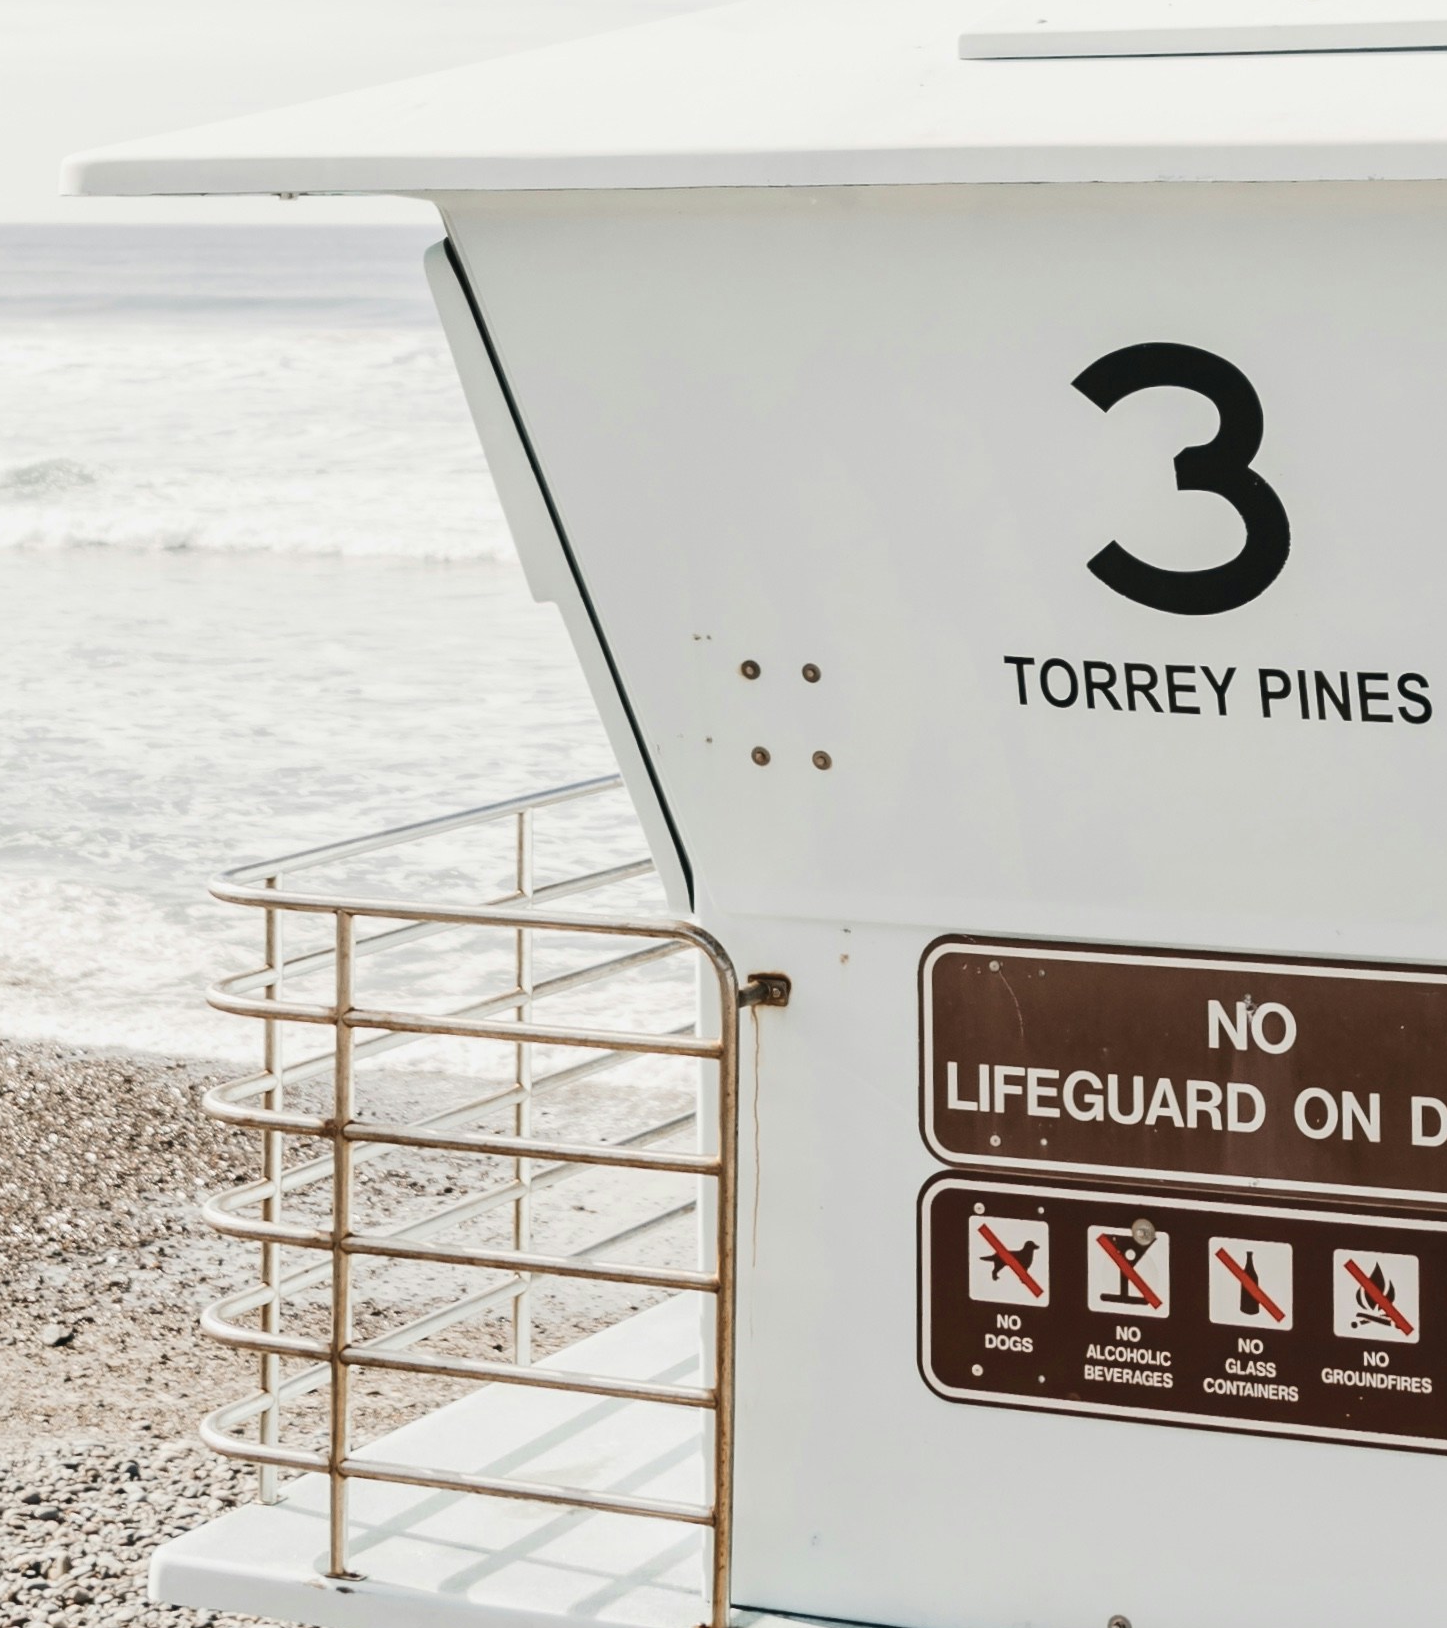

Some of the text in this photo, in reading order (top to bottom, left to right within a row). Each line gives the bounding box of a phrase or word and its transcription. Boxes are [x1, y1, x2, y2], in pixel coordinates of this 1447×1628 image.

[1071, 343, 1290, 615] 3
[1004, 656, 1432, 724] TORREY PINES
[1208, 1000, 1296, 1054] NO
[948, 1062, 1266, 1132] LIFEGUARD
[1294, 1088, 1380, 1142] ON
[997, 1314, 1021, 1330] NO
[985, 1334, 1033, 1352] DOGS
[1117, 1326, 1141, 1342] NO
[1086, 1344, 1172, 1366] ALCOHOLIC
[1239, 1338, 1263, 1354] NO
[1226, 1359, 1276, 1377] GLASS
[1364, 1352, 1389, 1367] NO
[1085, 1365, 1173, 1387] BEVERAGES
[1322, 1368, 1432, 1393] GROUNDFIRES
[1204, 1378, 1298, 1401] CONTAINERS
